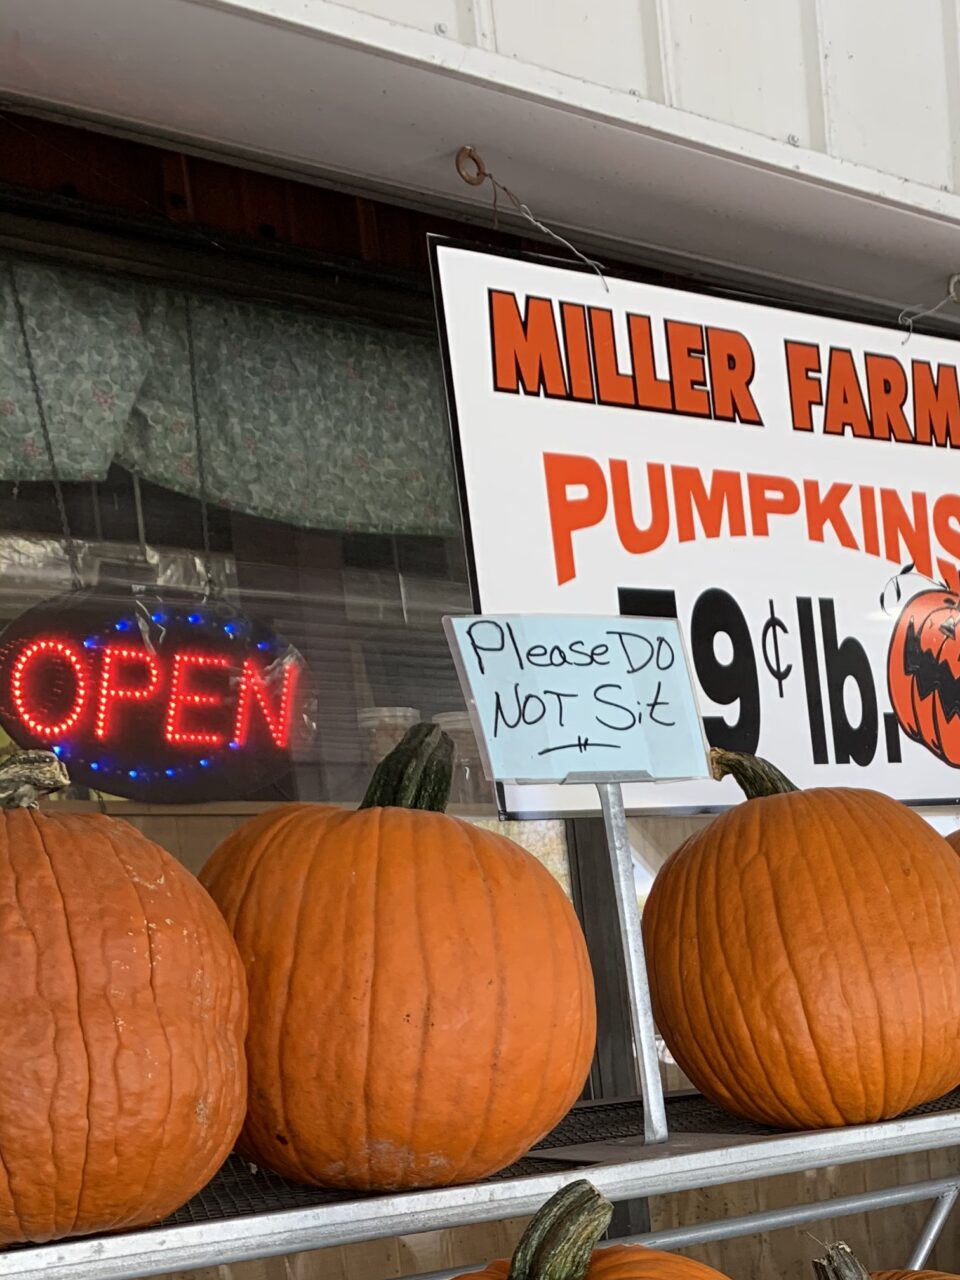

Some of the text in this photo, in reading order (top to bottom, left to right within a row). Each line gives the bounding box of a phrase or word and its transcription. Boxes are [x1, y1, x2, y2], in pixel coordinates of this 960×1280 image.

[487, 287, 765, 427] MILLER
[11, 638, 297, 748] OPEN
[466, 620, 610, 675] Please
[617, 586, 793, 757] 9¢
[493, 681, 676, 738] NOT Sit
